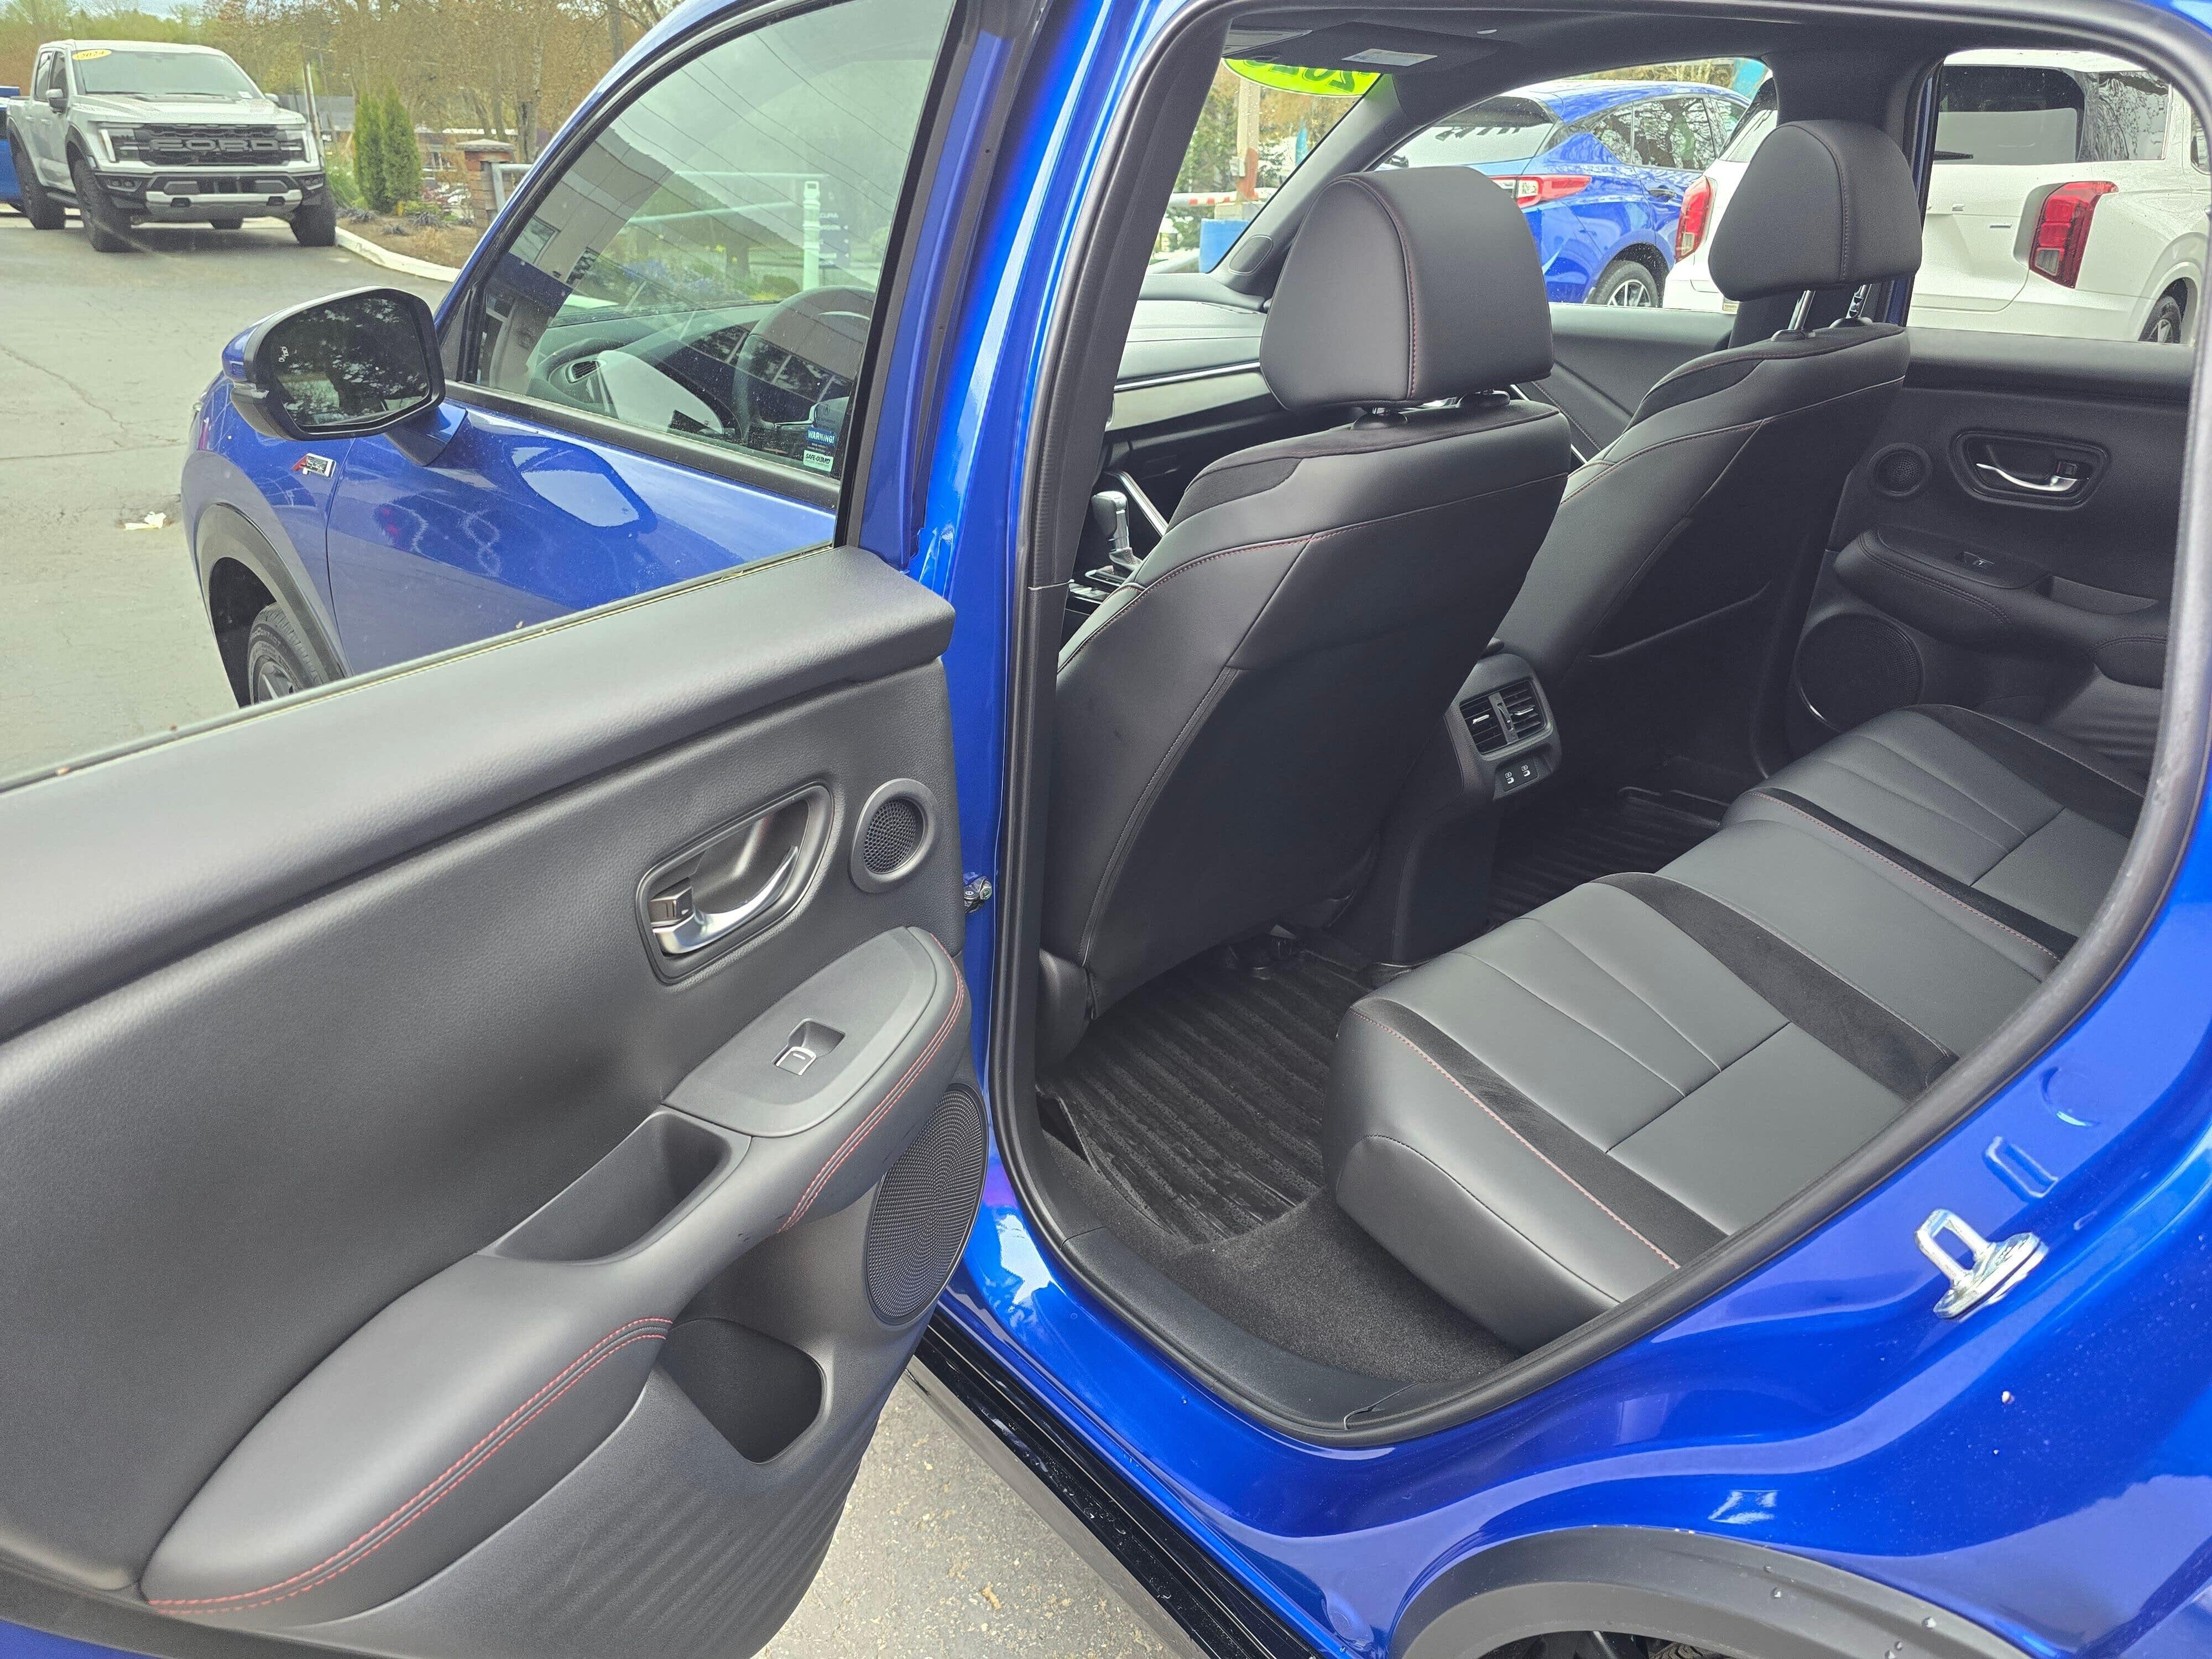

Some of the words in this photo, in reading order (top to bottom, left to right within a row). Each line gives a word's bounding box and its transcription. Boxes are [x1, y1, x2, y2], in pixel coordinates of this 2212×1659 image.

[150, 138, 280, 151] FORD
[808, 430, 835, 444] WARNING!
[805, 453, 831, 465] SAFE-GUARD
